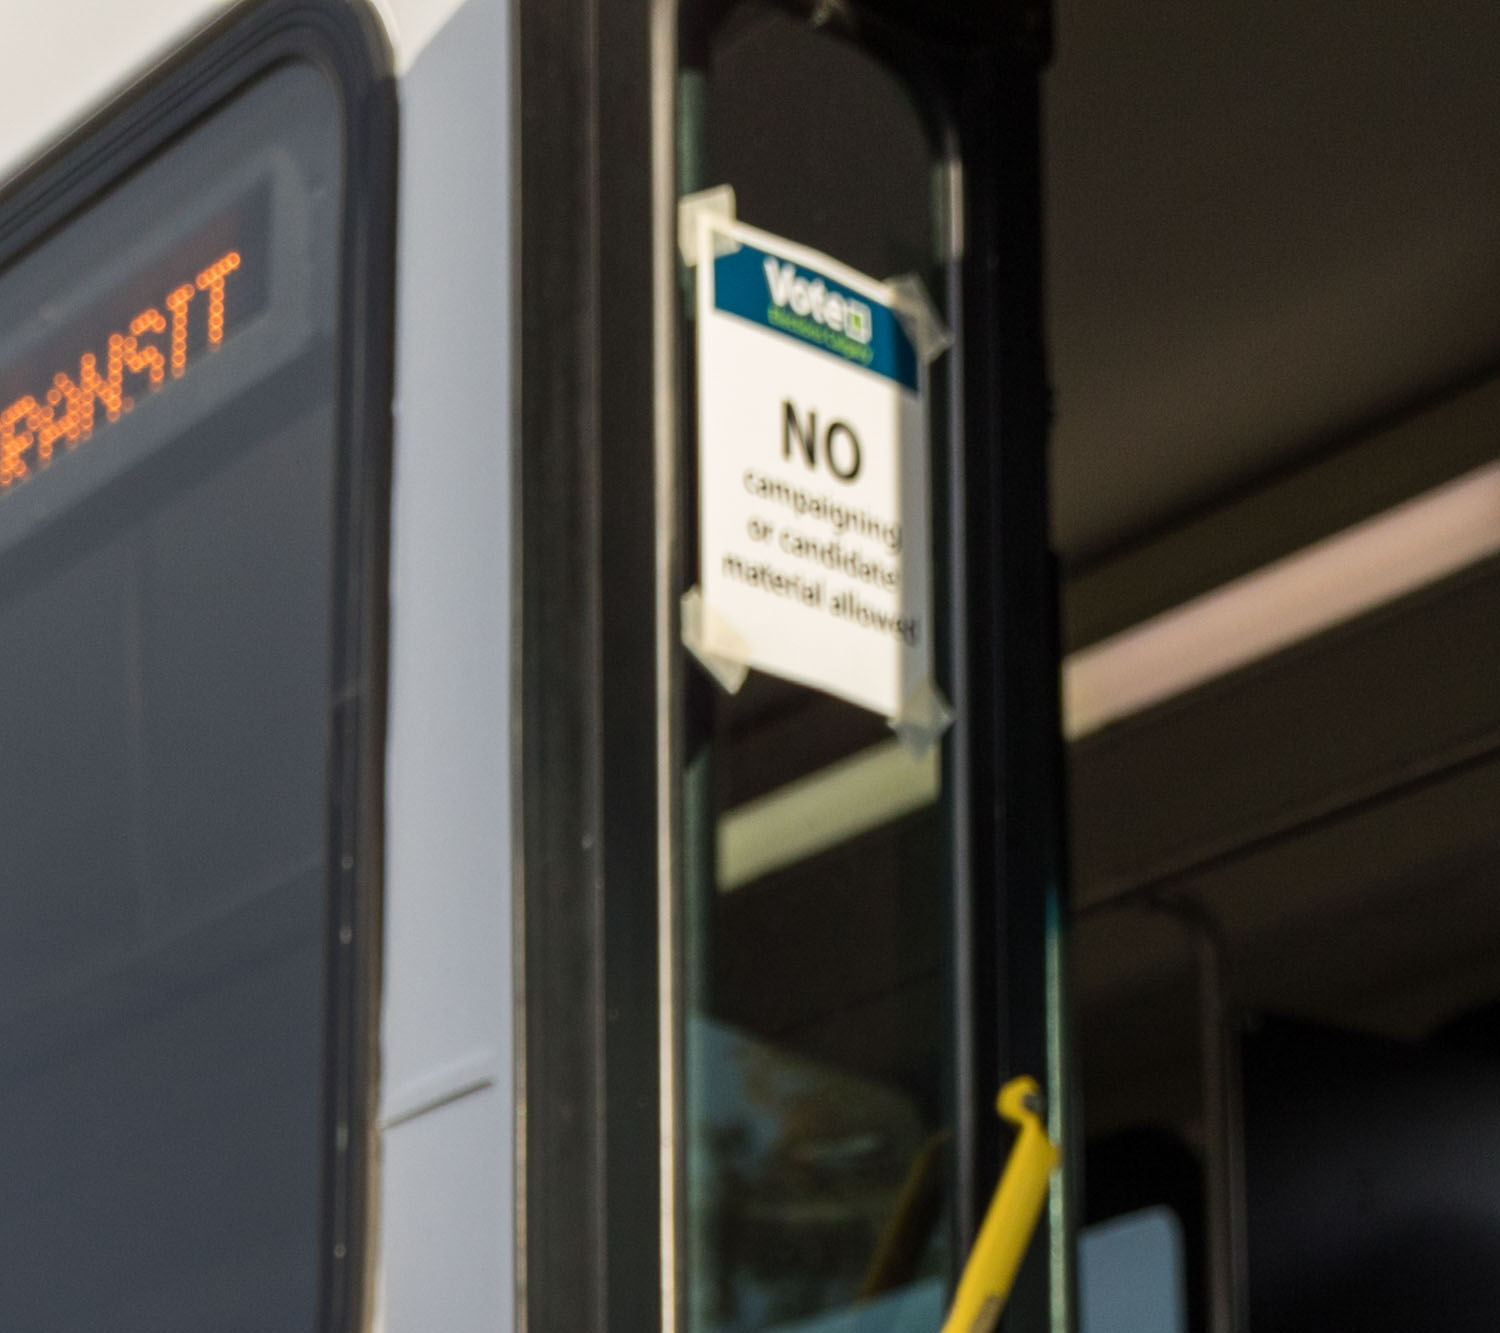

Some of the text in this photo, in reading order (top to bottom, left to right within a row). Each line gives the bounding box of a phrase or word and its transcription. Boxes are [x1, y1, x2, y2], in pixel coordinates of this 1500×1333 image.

[762, 254, 846, 333] Vote
[780, 398, 862, 484] NO
[743, 468, 900, 557] campaigning
[746, 518, 773, 544] or
[721, 553, 821, 606] material
